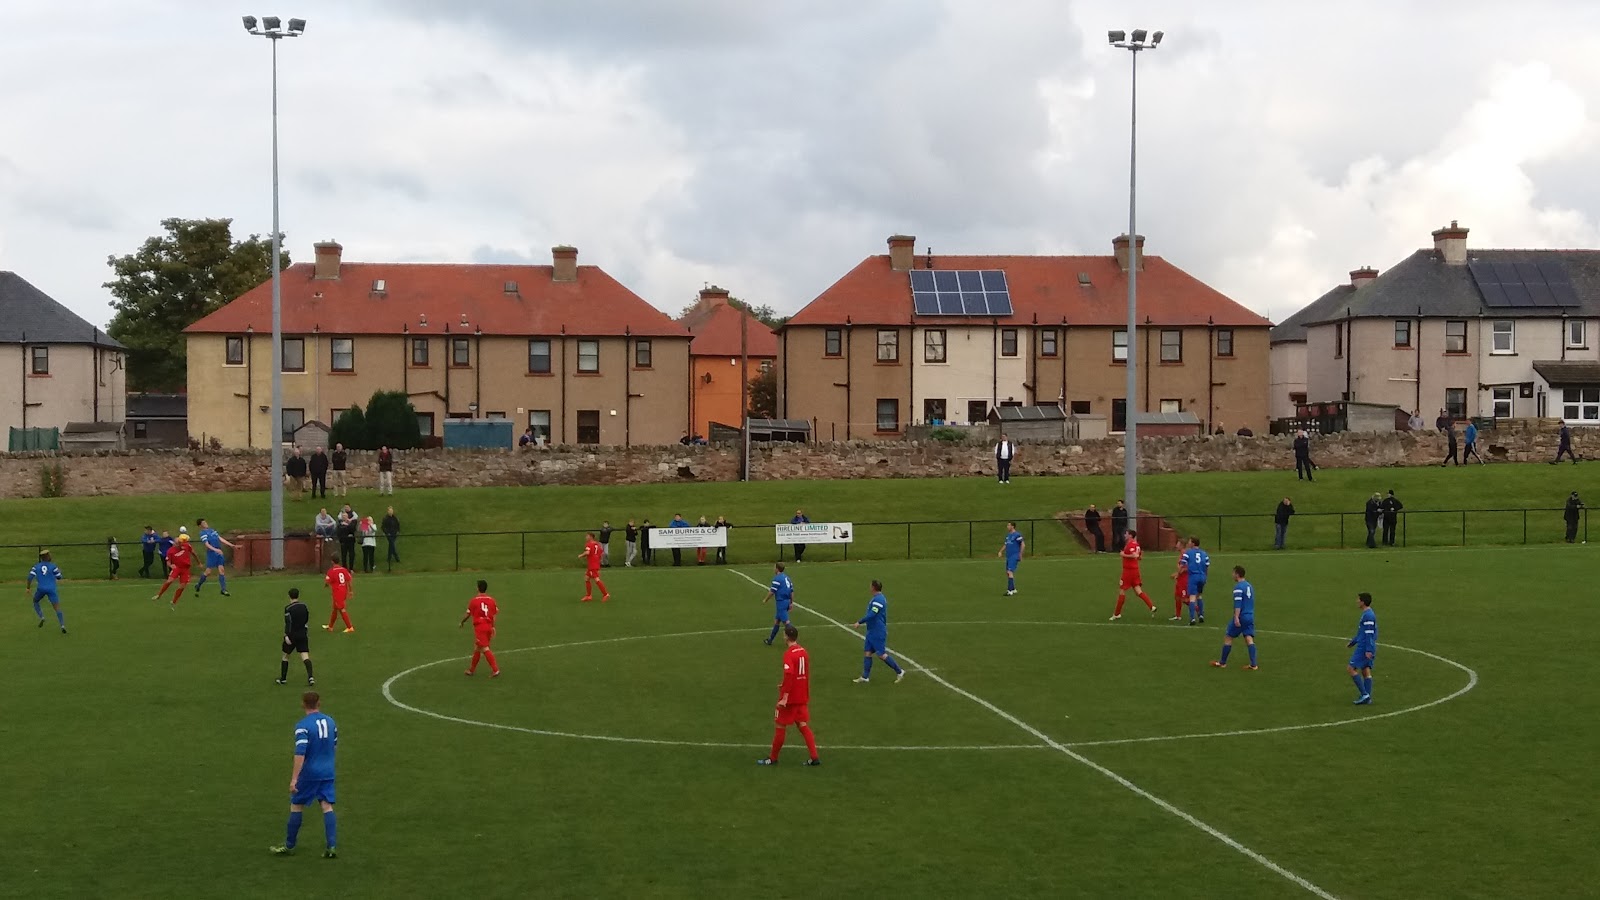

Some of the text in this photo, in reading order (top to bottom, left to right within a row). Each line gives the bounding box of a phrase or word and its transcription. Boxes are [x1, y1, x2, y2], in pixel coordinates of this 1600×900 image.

[1195, 552, 1202, 564] 5
[41, 565, 48, 575] 9
[338, 572, 345, 584] 8
[1246, 586, 1252, 599] 4
[480, 602, 489, 617] 4
[798, 656, 806, 675] 11
[315, 718, 328, 739] 11
